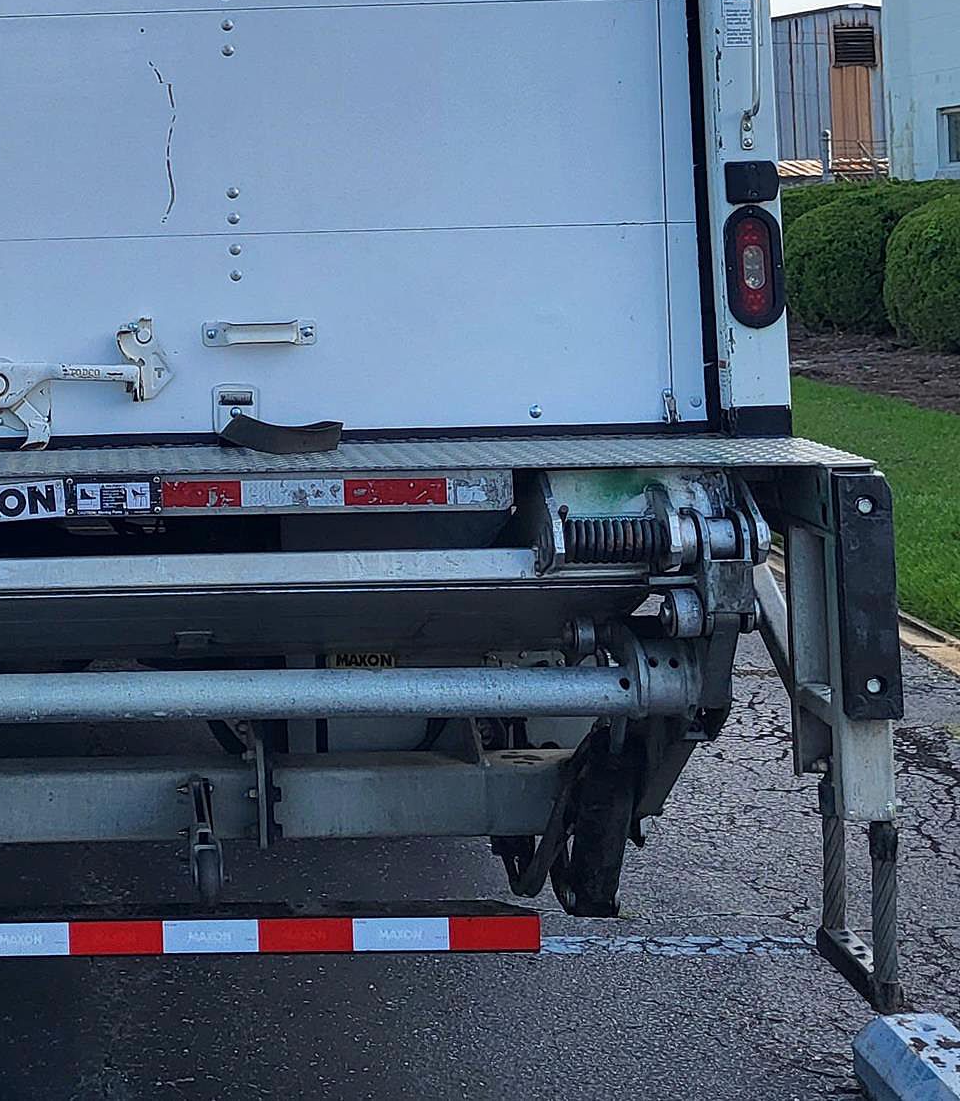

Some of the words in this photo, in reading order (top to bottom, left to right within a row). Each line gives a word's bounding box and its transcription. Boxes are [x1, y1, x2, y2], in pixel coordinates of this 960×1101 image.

[335, 654, 393, 667] MAXON
[0, 934, 43, 945] MAXON
[379, 929, 423, 940] MAXON
